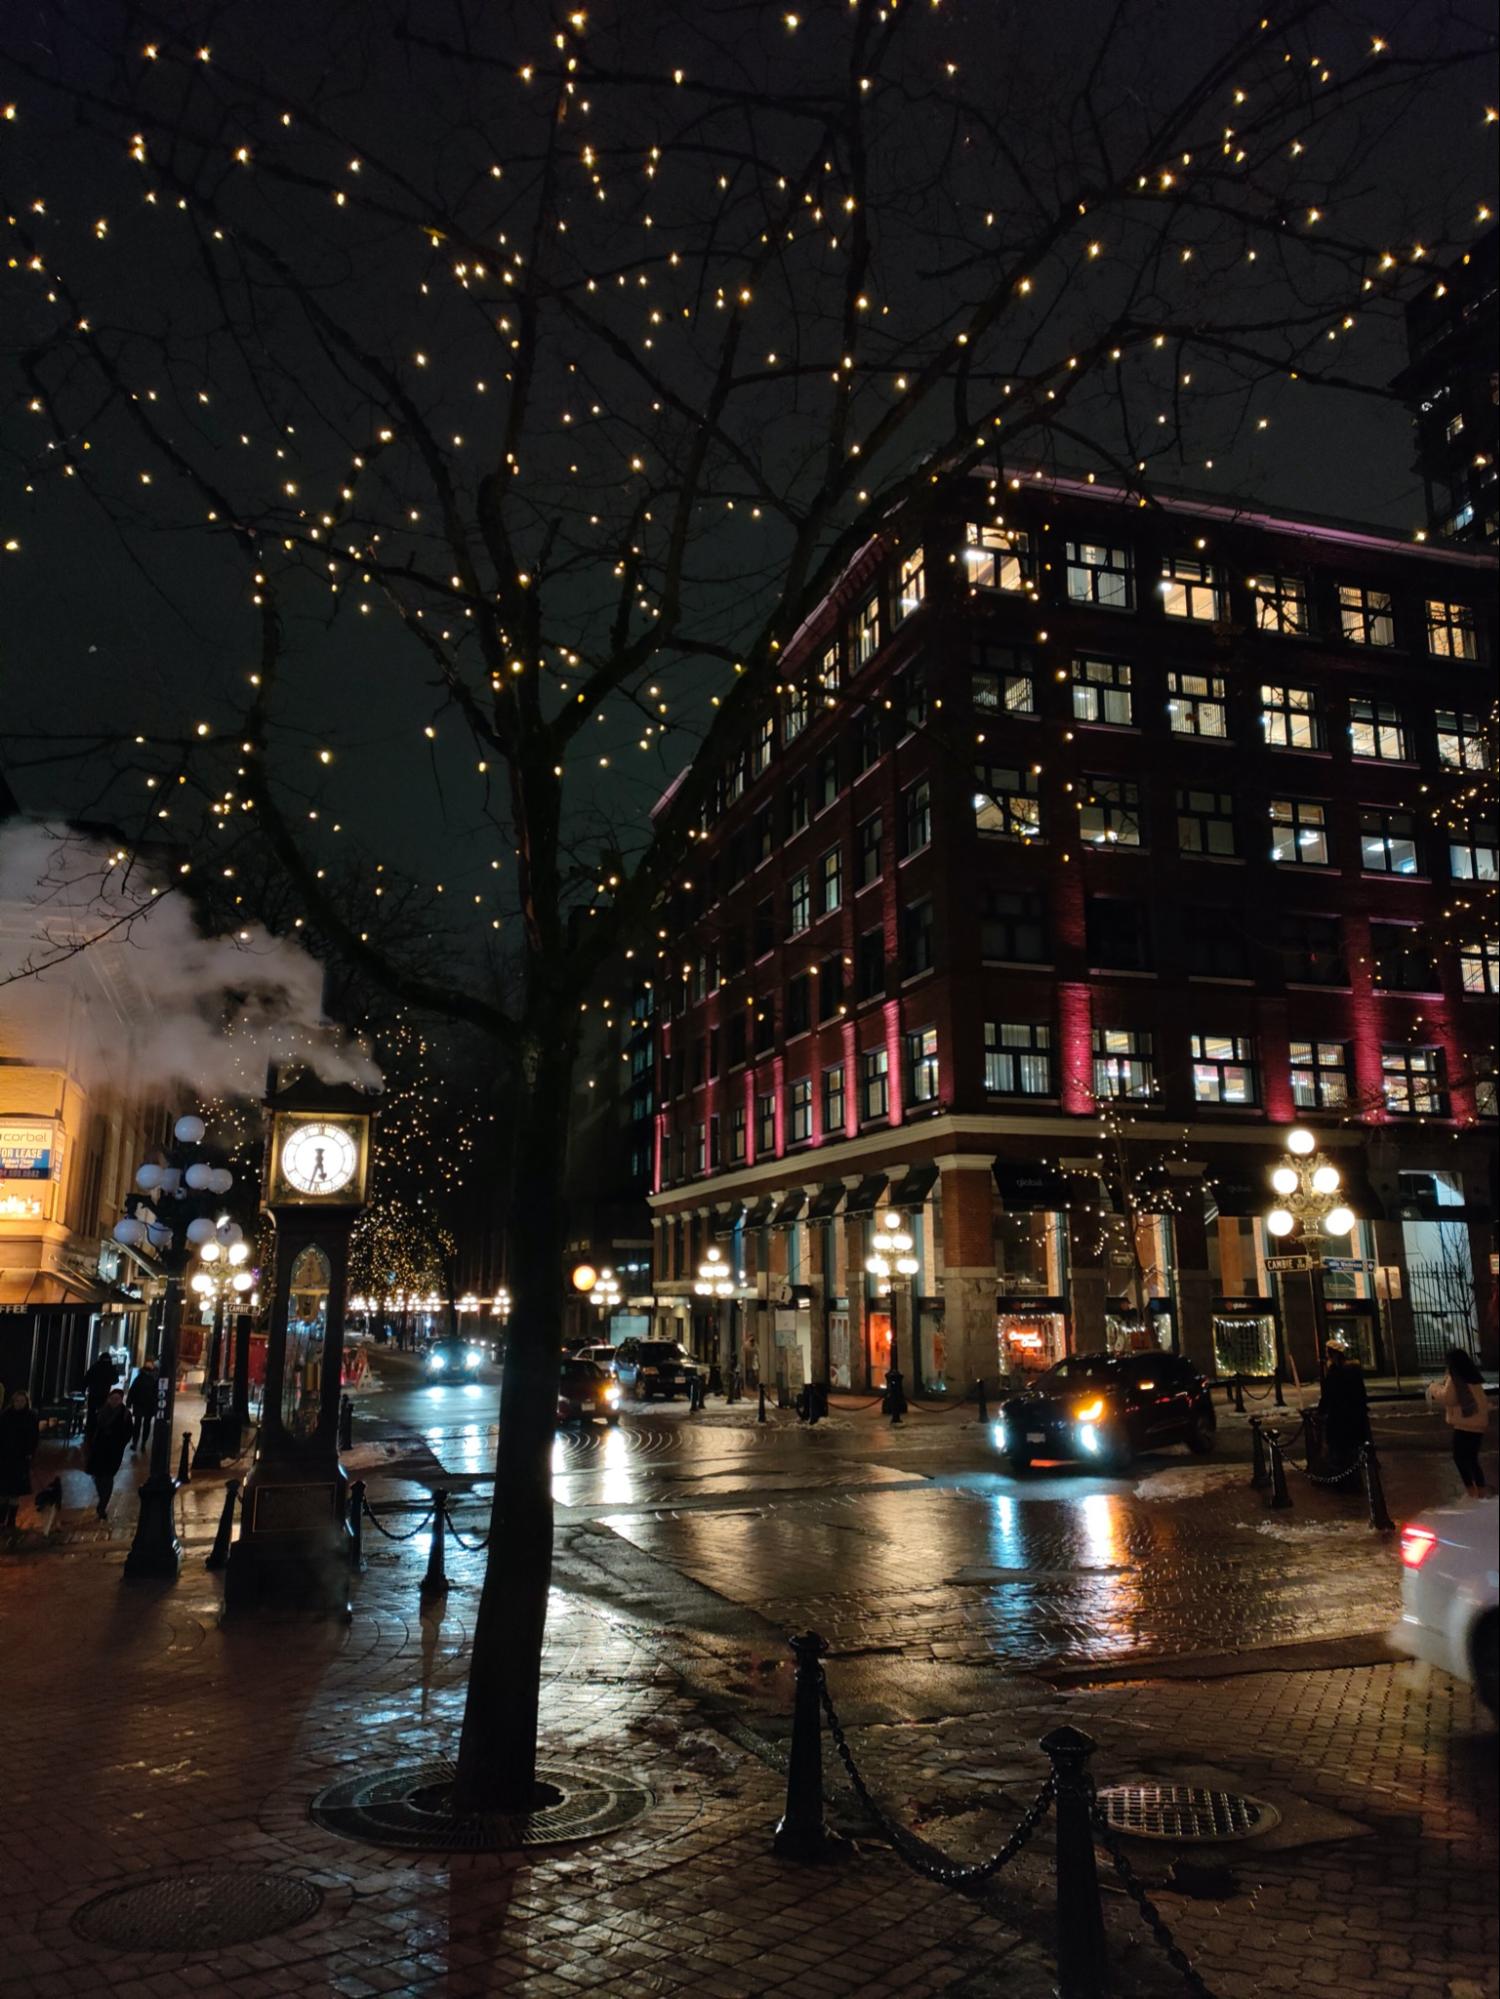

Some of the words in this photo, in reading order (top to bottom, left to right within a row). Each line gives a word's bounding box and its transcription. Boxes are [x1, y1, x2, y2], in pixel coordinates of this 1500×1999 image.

[4, 1131, 47, 1143] corbel
[0, 1149, 14, 1158] OR
[16, 1149, 42, 1159] LEASE
[1267, 1258, 1293, 1270] CAMBIE
